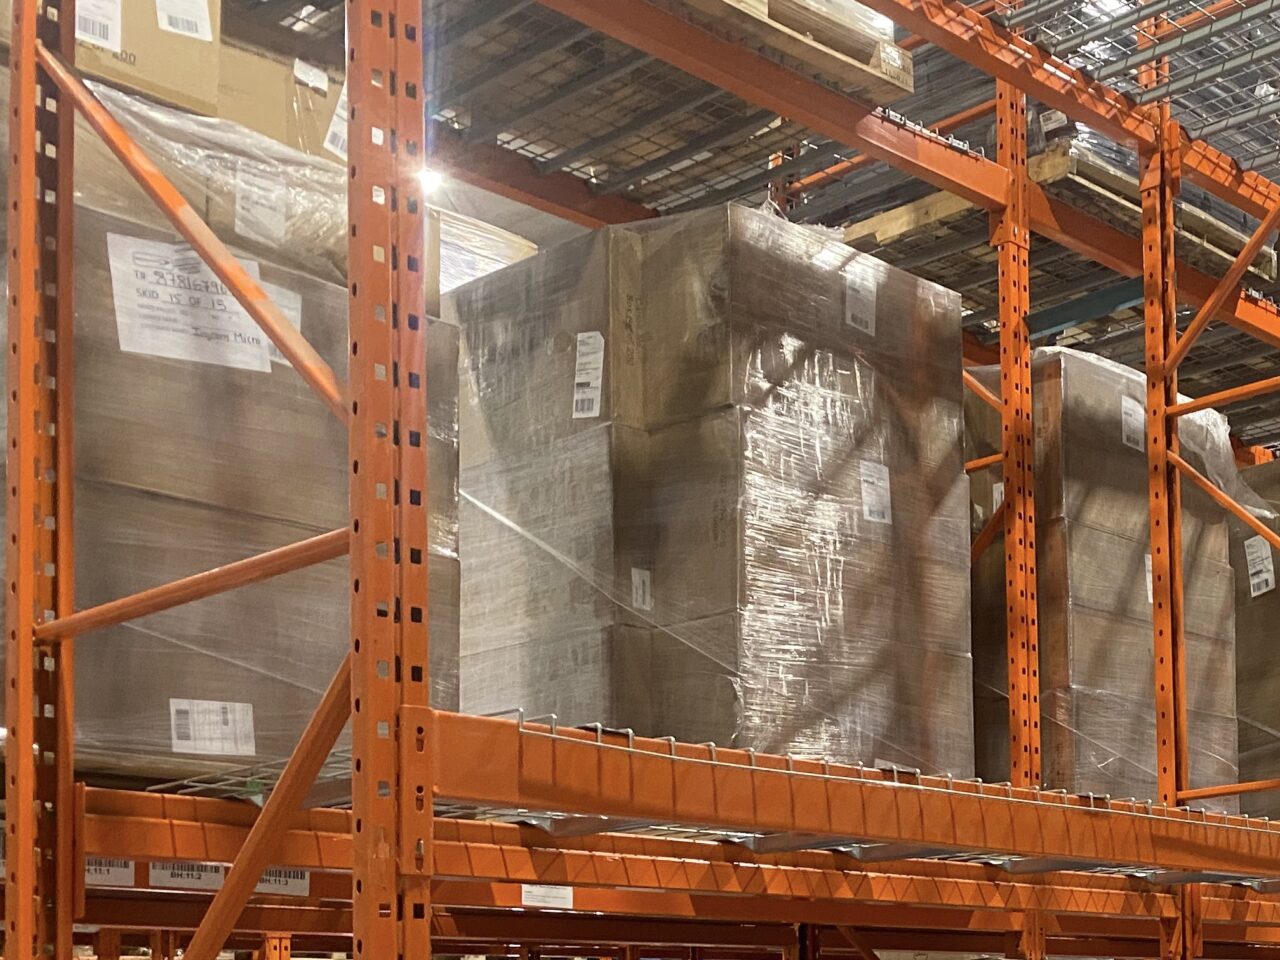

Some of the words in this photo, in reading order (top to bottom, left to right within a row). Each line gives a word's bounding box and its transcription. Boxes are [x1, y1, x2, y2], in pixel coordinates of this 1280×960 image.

[136, 288, 159, 299] SKID
[169, 292, 183, 304] 15
[210, 298, 227, 311] 15
[233, 332, 261, 345] Micro
